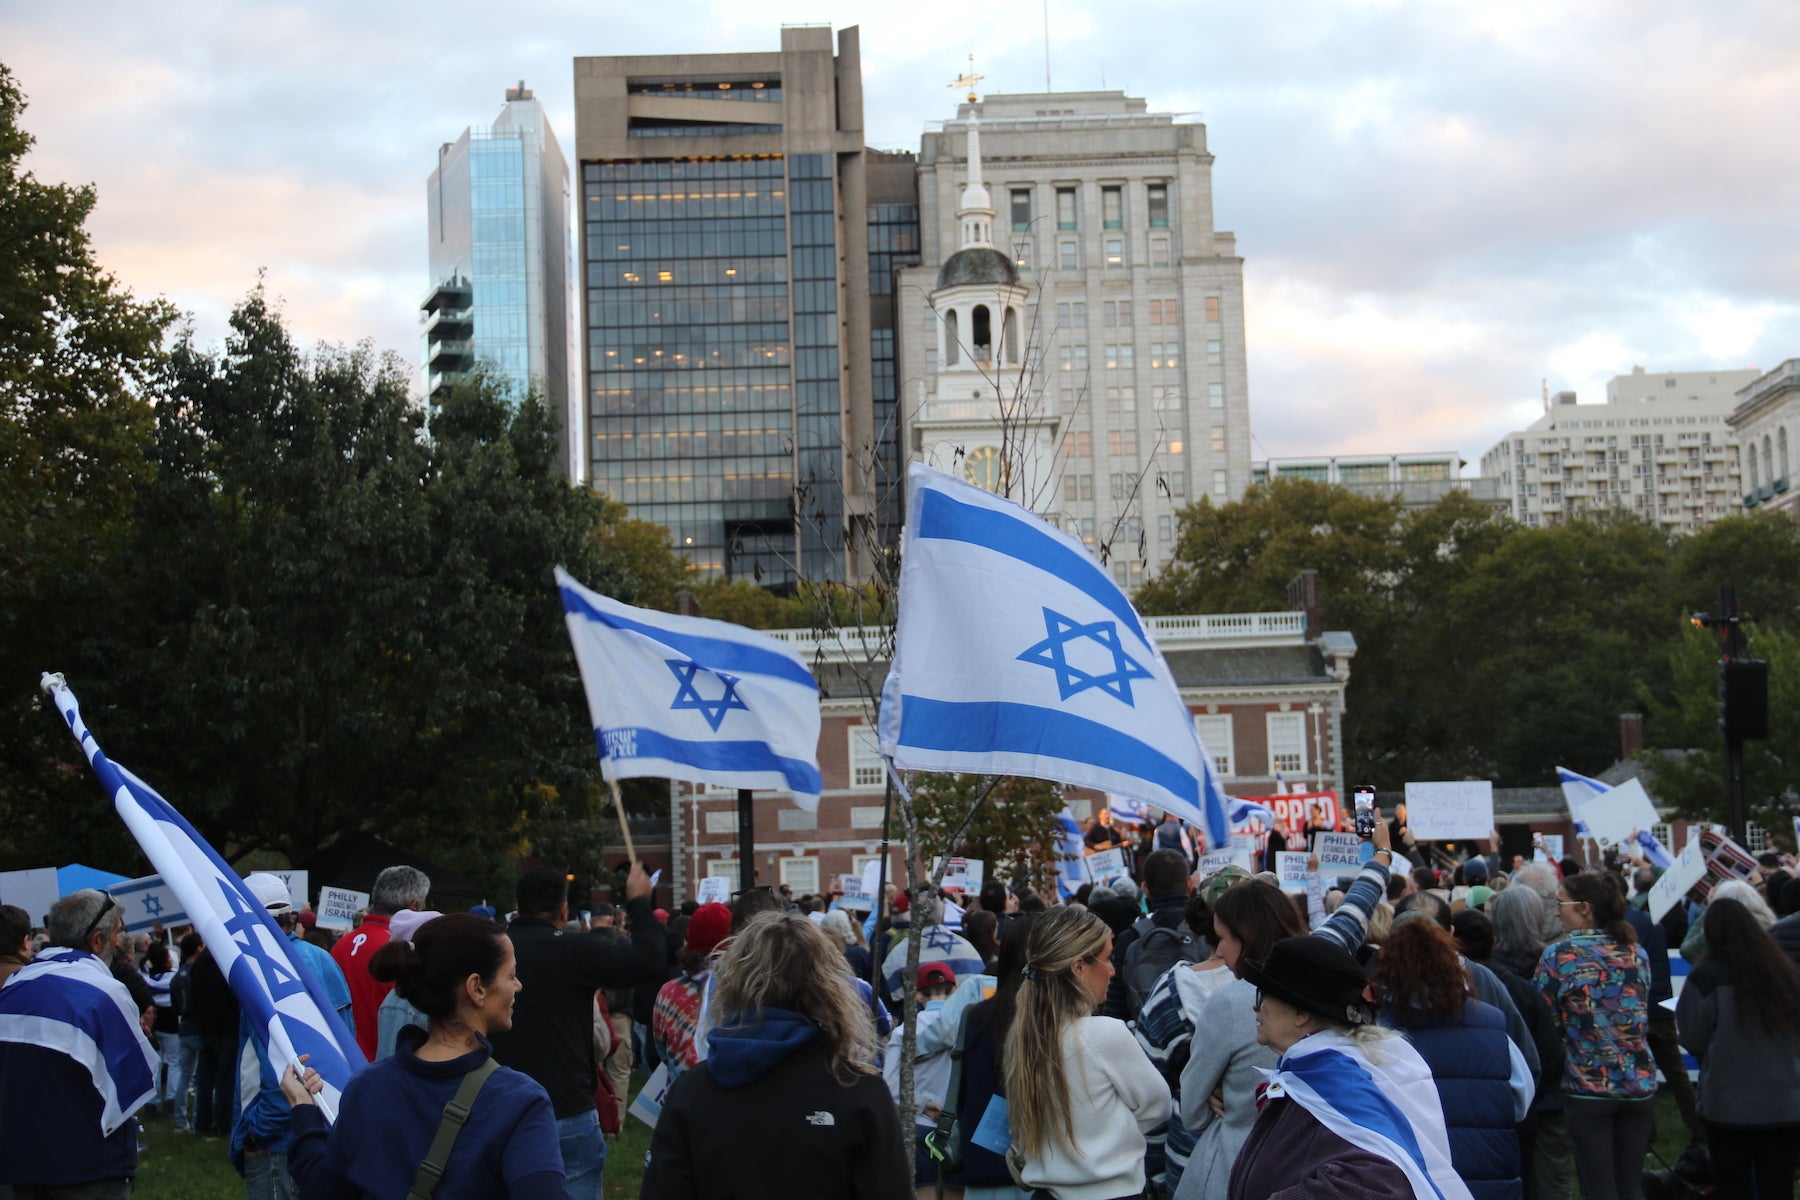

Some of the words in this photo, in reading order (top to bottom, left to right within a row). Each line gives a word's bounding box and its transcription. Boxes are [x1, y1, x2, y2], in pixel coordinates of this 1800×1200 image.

[1203, 856, 1234, 865] PHILLY
[1321, 853, 1361, 865] ISRAEL
[1284, 872, 1307, 882] ISRA
[328, 890, 358, 903] PHILLY
[327, 900, 346, 910] STANDS
